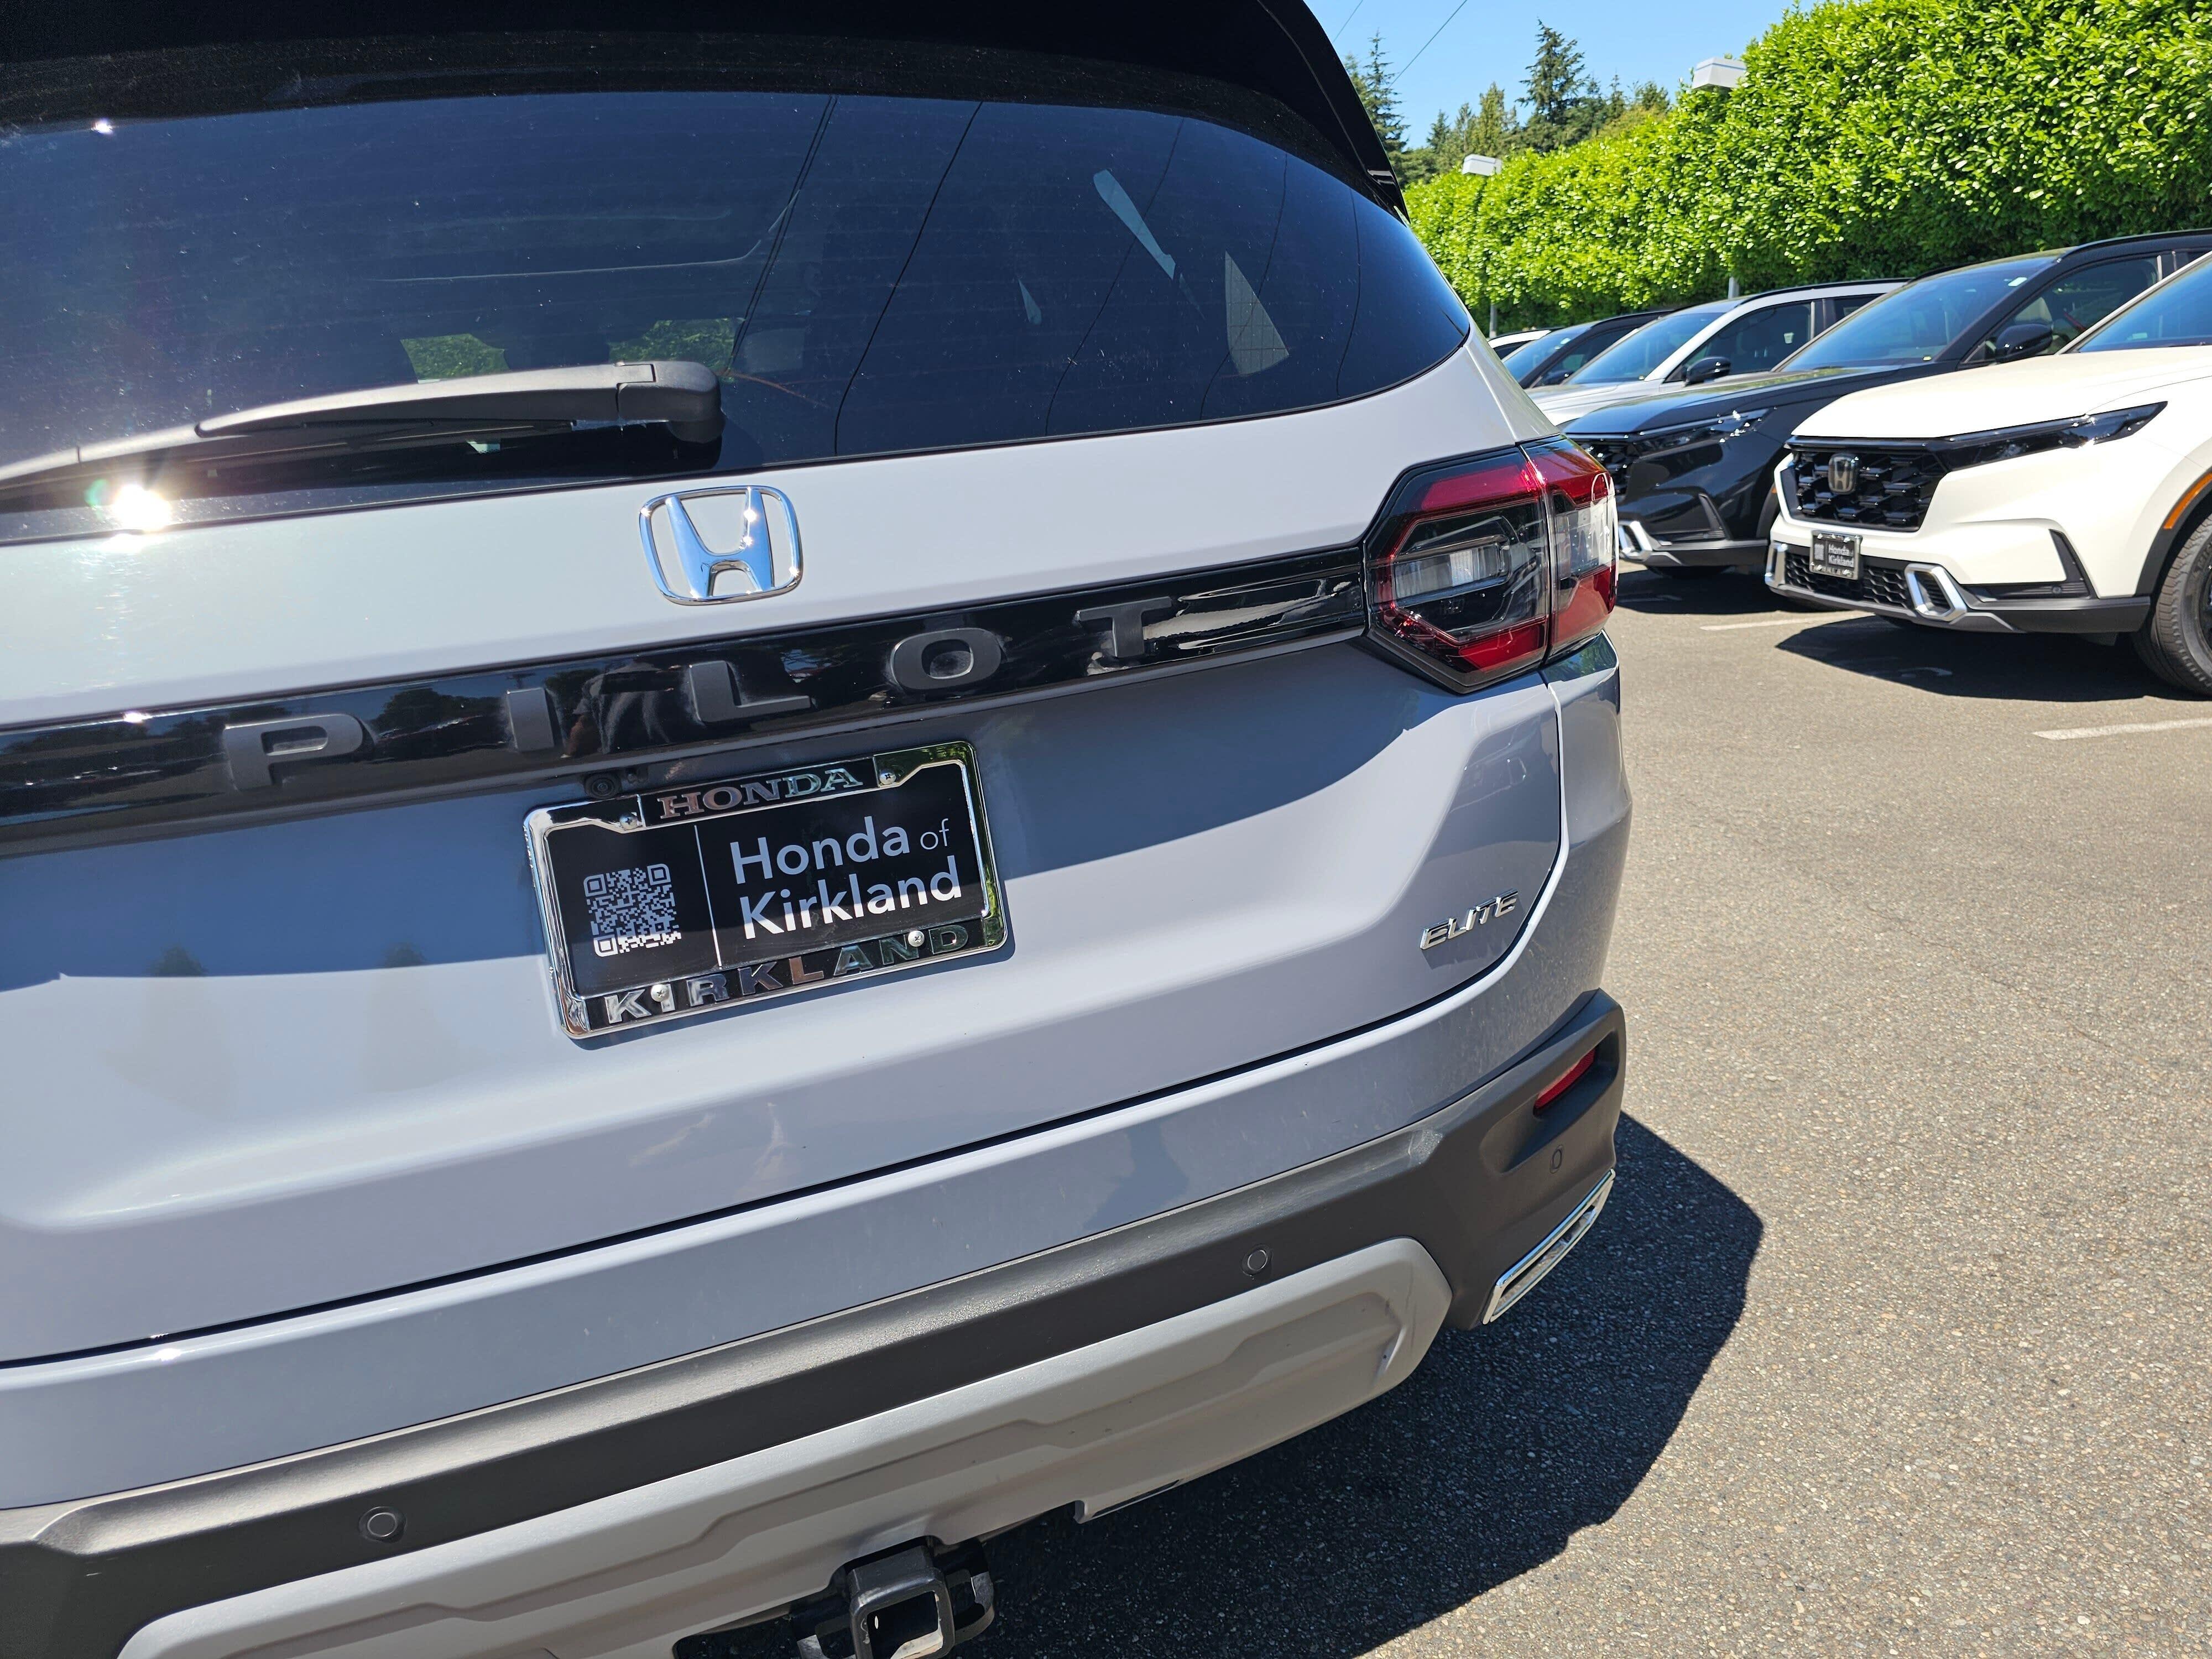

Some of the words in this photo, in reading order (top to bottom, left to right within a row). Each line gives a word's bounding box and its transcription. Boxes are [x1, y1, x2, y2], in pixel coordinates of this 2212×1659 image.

[1828, 544, 1850, 556] Honda
[1828, 555, 1854, 567] Kirkland
[222, 596, 1173, 791] PILOT
[657, 768, 863, 820] HONDA
[730, 815, 910, 885] Honda
[920, 818, 950, 851] of
[741, 855, 962, 940] Kirkland
[1420, 889, 1518, 950] ELITE
[602, 925, 969, 1025] KIRKLAND
